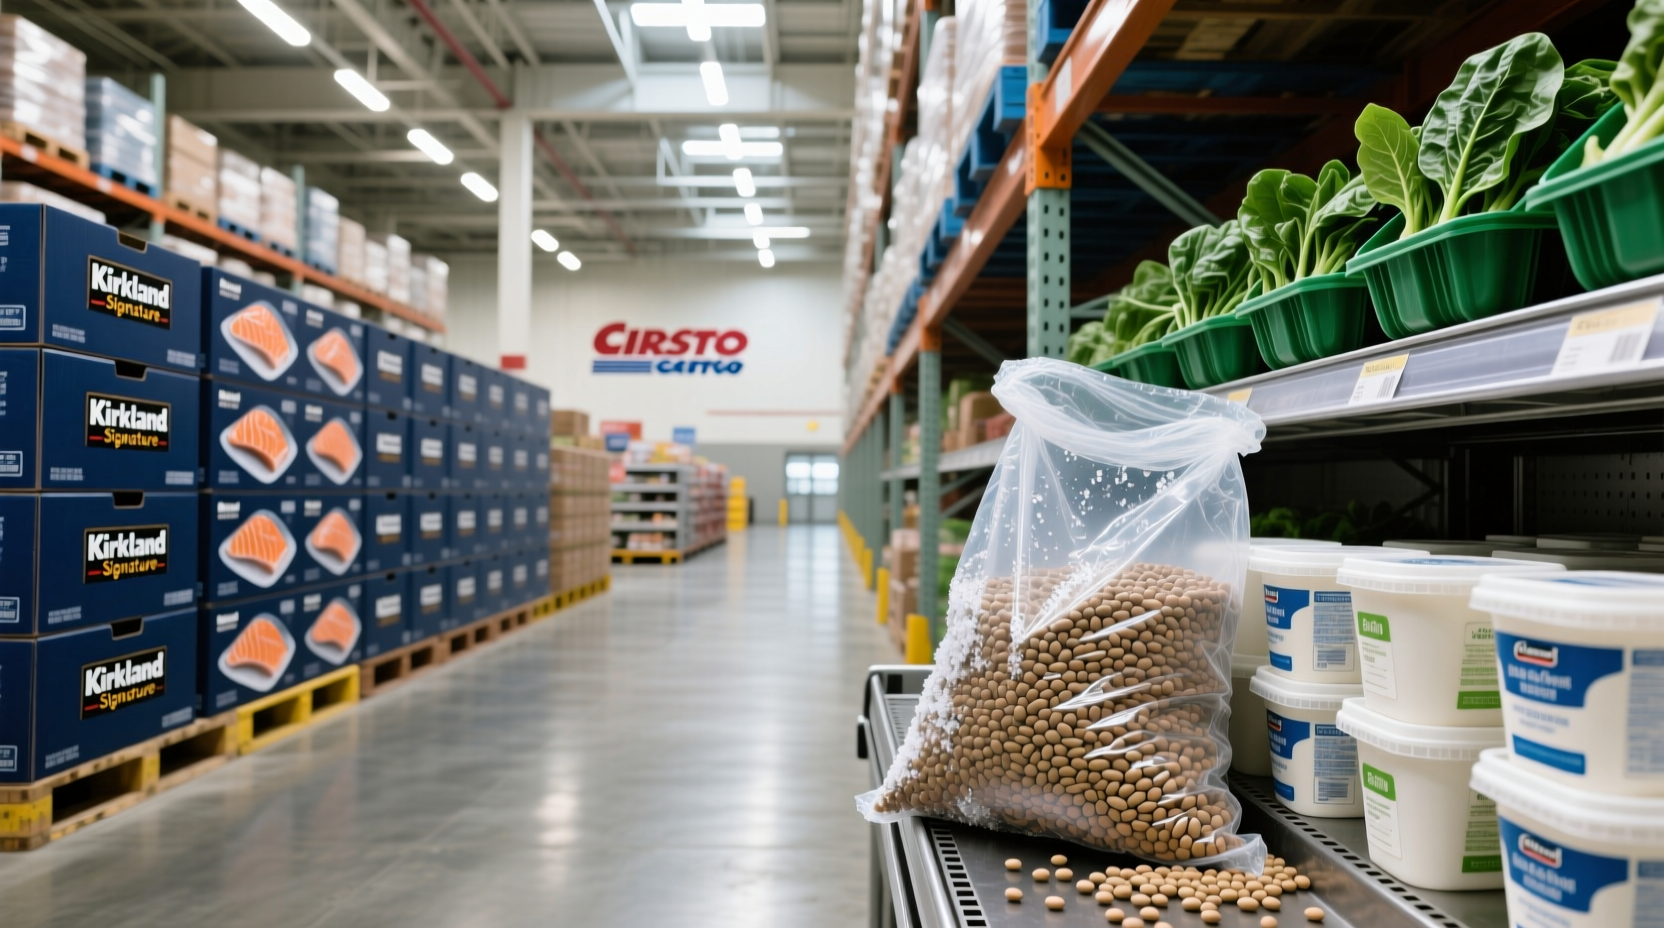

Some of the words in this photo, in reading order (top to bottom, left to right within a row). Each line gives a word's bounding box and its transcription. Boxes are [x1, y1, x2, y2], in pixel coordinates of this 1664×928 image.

[91, 262, 170, 309] Kirkland
[593, 322, 748, 356] CIRSTO
[89, 397, 169, 433] Kirkland
[87, 529, 167, 562] Kirkland
[85, 651, 164, 697] Kirkland
